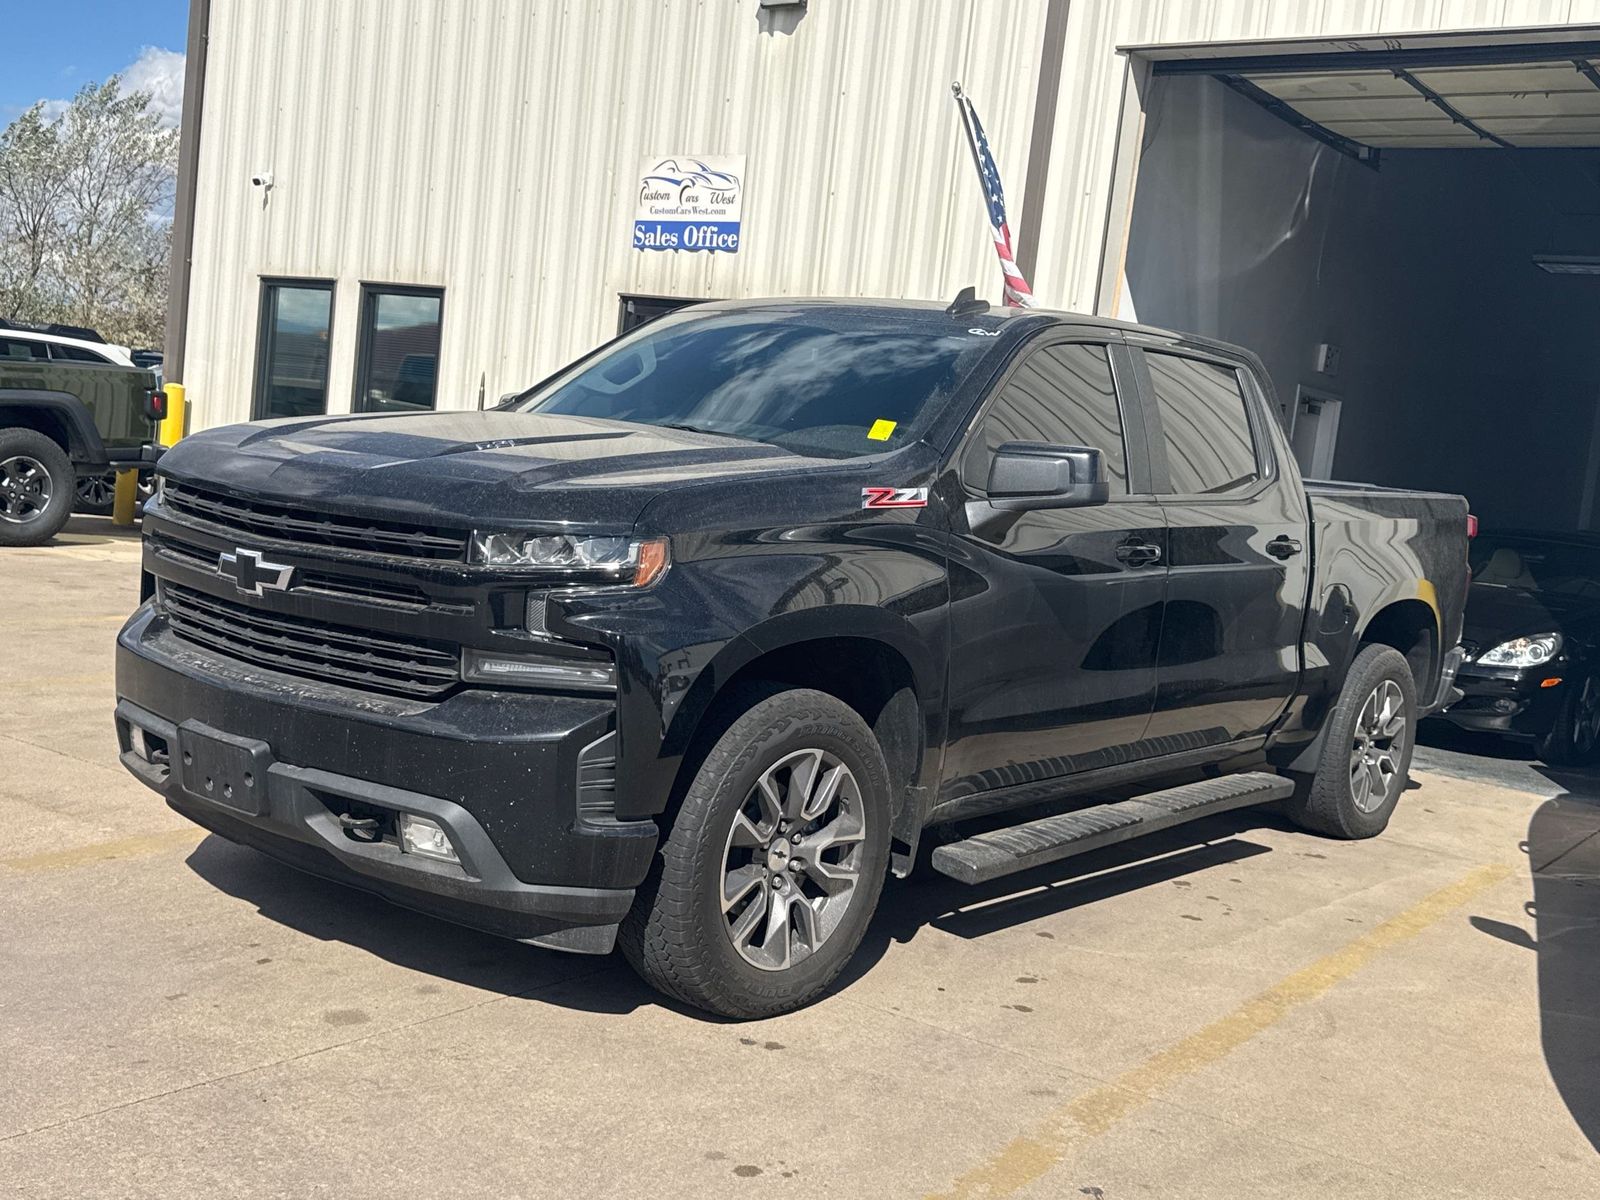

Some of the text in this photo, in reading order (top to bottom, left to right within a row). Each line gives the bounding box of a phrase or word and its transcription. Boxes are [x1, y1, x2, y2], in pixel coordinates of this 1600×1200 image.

[640, 185, 736, 206] Custom Cars West
[650, 206, 726, 215] CustomCarsWest.com
[634, 225, 738, 248] Sales Office
[862, 487, 928, 510] Z71
